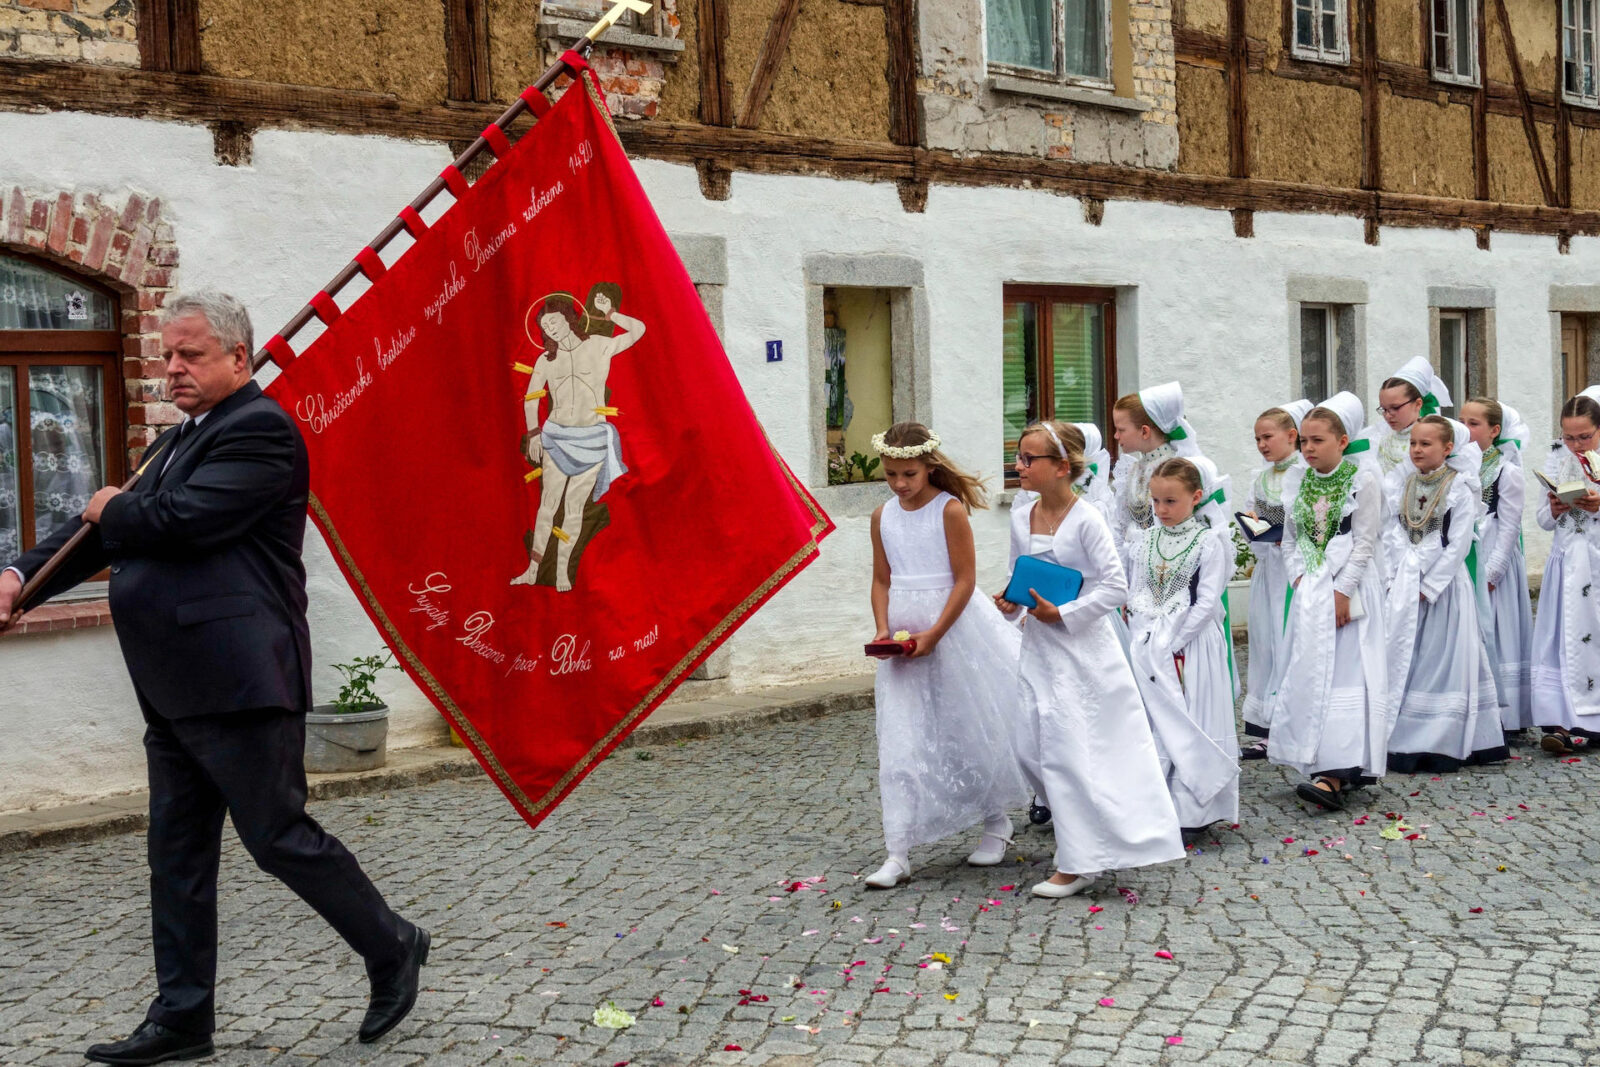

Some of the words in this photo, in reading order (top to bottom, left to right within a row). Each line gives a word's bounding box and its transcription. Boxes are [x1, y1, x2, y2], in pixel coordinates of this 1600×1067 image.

[772, 343, 778, 359] 1
[550, 634, 591, 676] Boha
[608, 645, 626, 661] za
[633, 624, 659, 652] nas!
